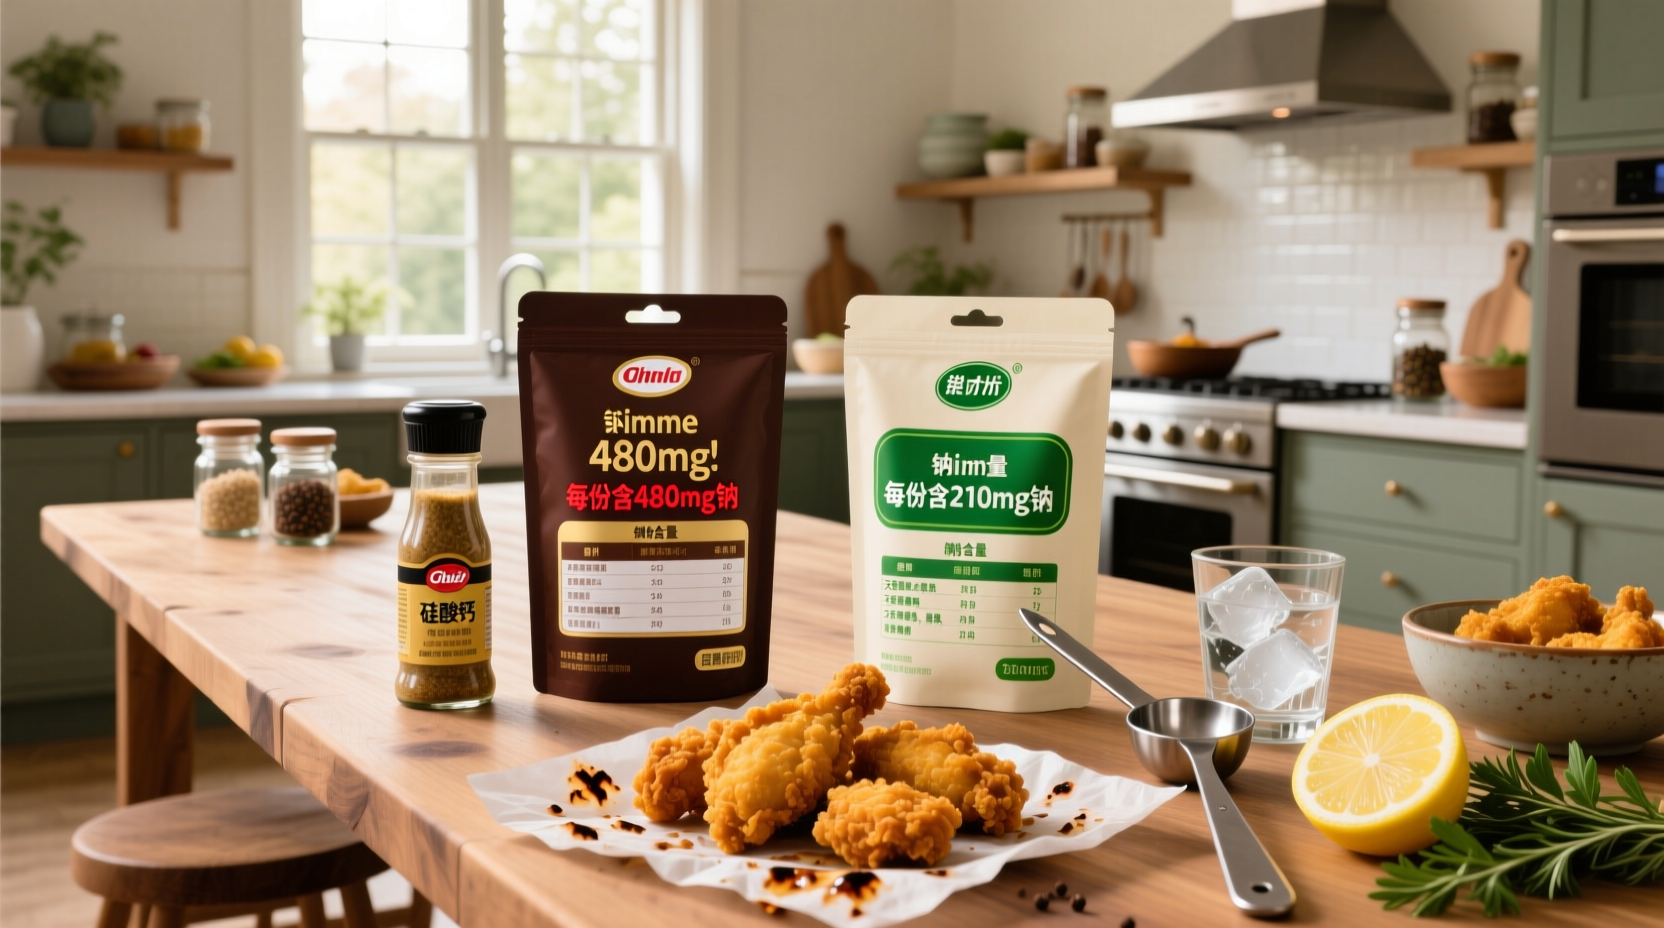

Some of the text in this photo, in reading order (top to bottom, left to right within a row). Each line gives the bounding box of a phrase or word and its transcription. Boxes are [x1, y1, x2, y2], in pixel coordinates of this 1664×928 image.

[589, 439, 718, 482] 480mg!
[566, 482, 739, 515] 每份含480mg钠
[884, 480, 1054, 517] 每份含210mg钠
[420, 600, 476, 624] 硅酸钙
